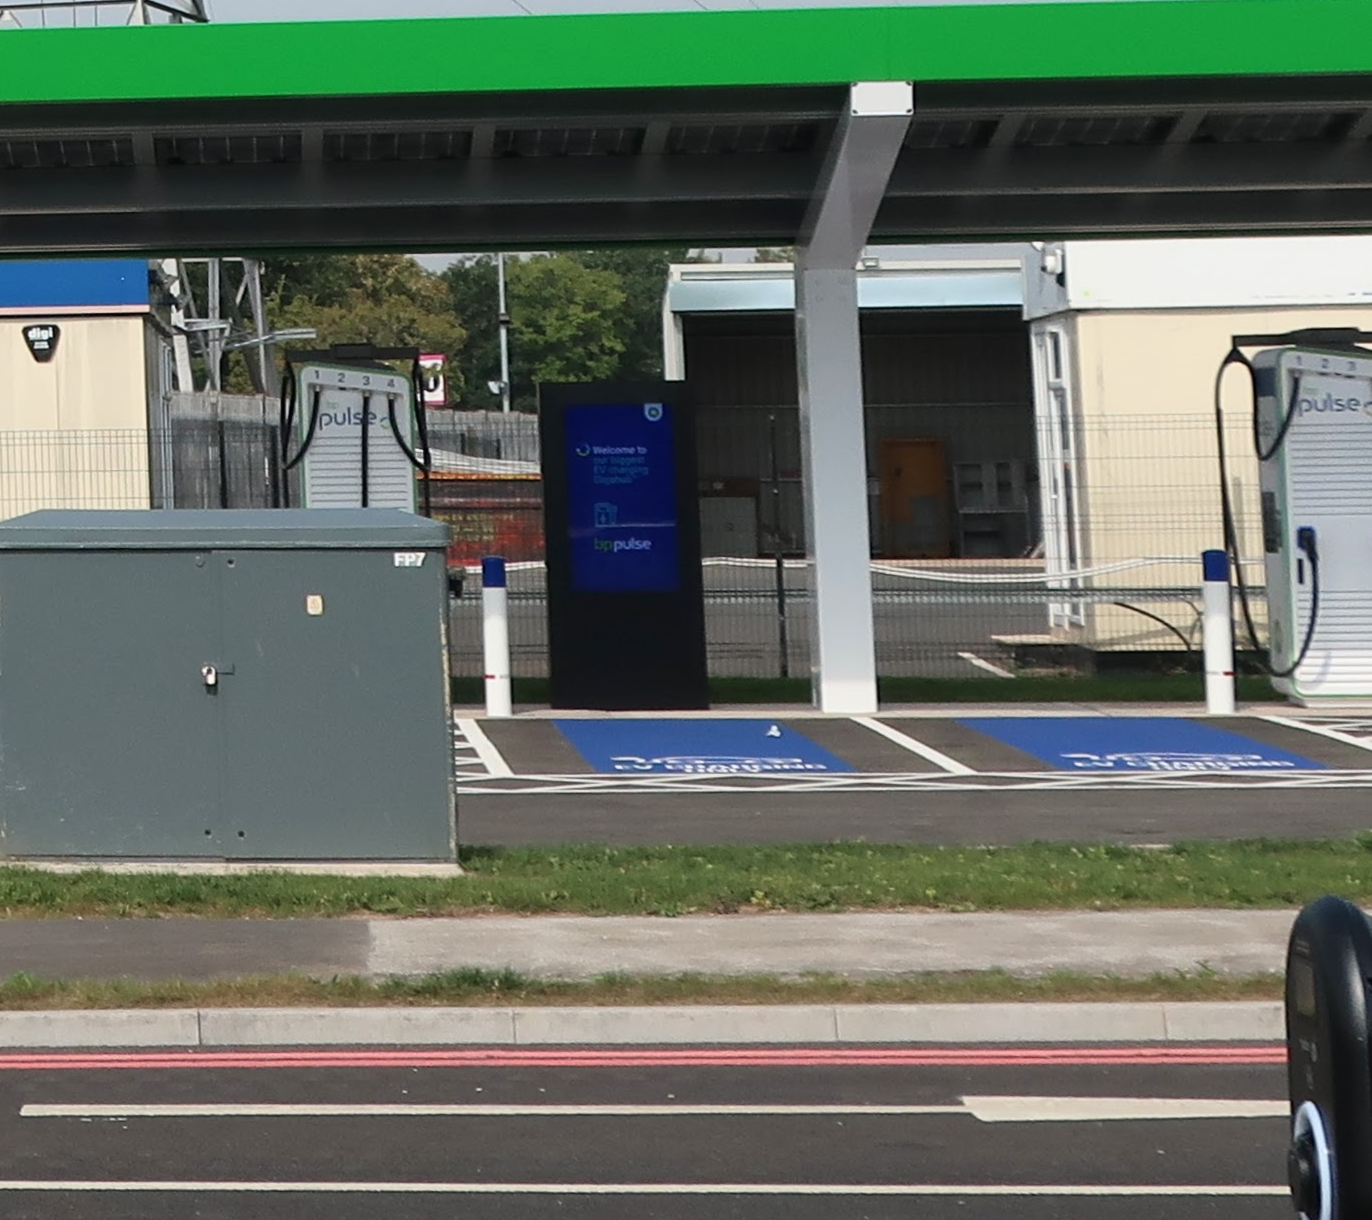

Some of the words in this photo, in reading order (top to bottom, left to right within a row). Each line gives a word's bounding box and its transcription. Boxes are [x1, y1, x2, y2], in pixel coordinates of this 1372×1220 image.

[28, 327, 54, 340] digi
[314, 370, 320, 379] 1
[337, 372, 346, 383] 2
[362, 375, 371, 386] 3
[387, 378, 395, 388] 4
[1298, 392, 1362, 418] pulse
[592, 446, 636, 455] Welcome
[613, 537, 652, 553] pulse
